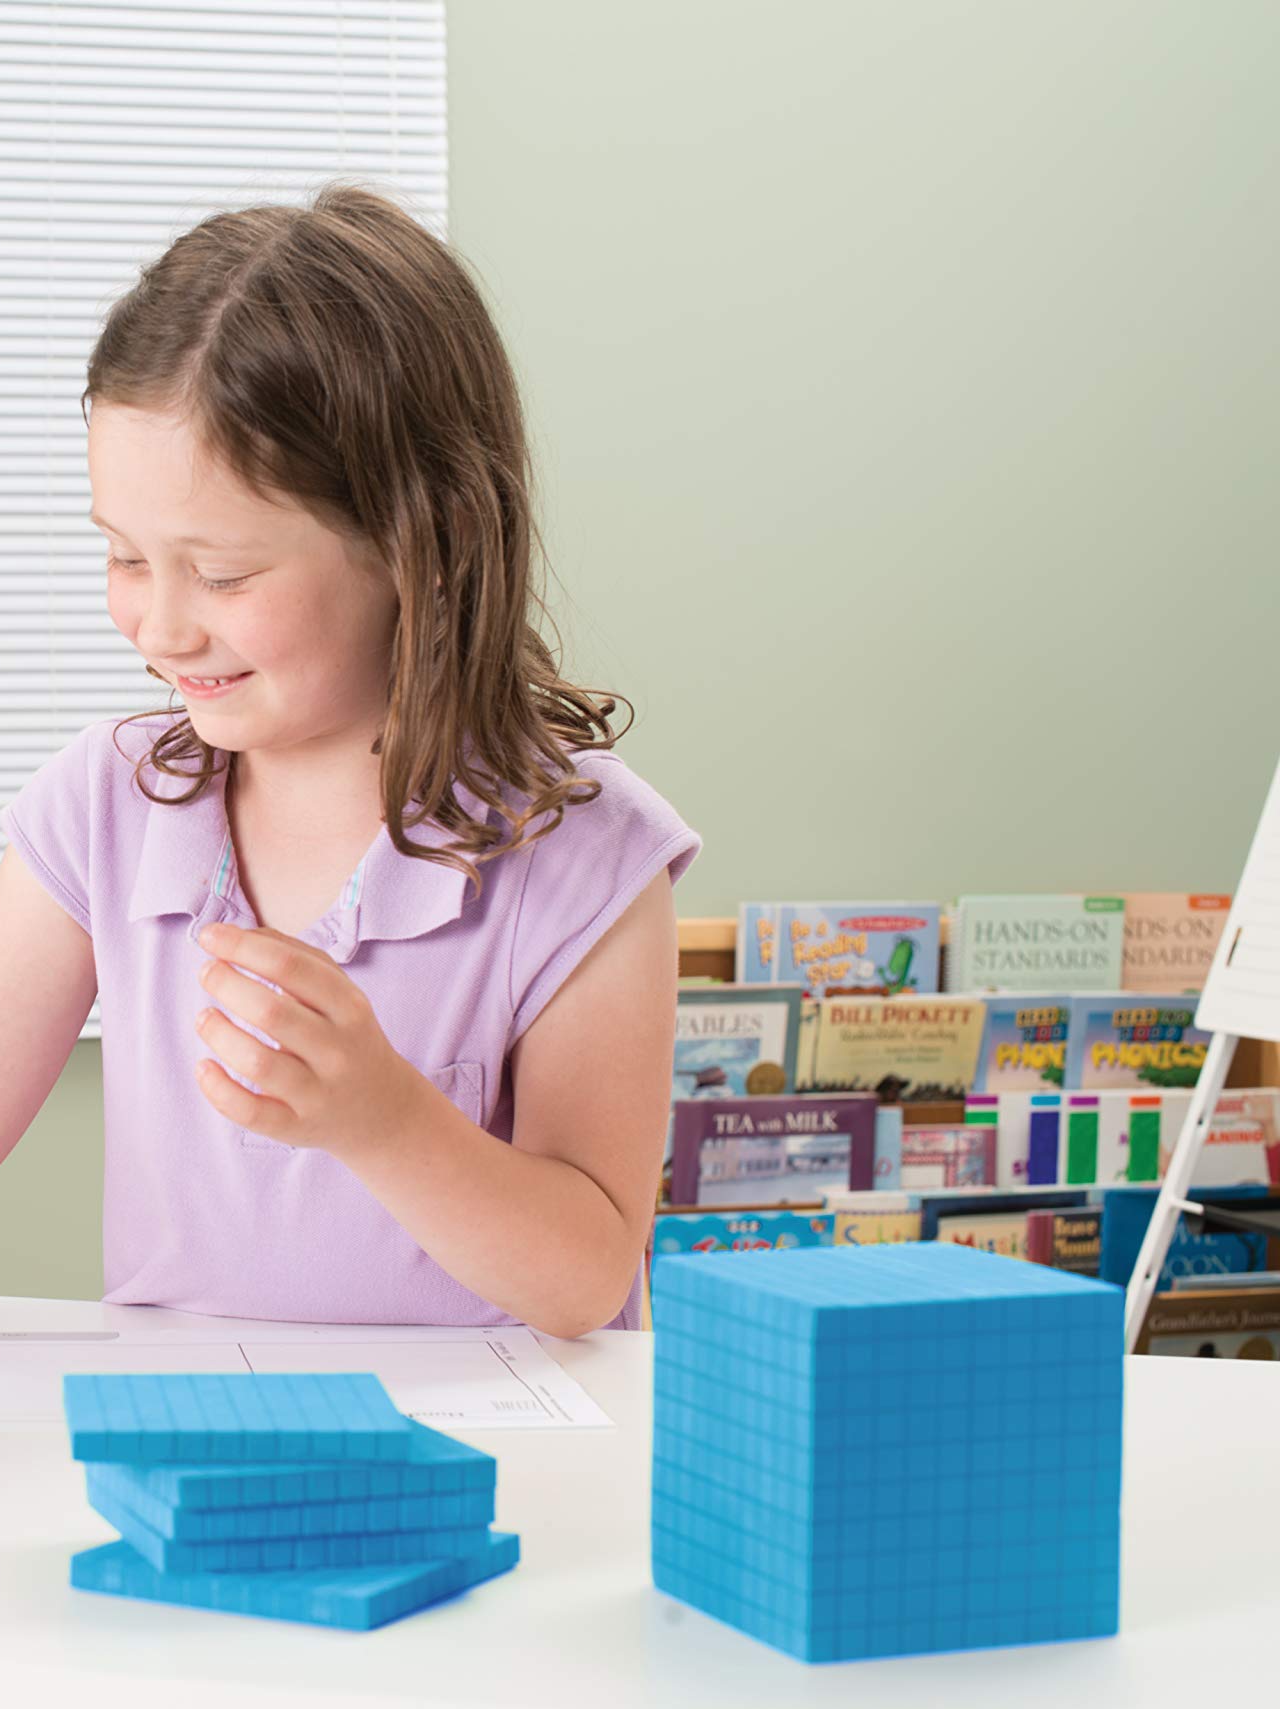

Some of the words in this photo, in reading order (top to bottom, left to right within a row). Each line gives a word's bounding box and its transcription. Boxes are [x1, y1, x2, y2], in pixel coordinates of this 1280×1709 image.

[974, 918, 1109, 945] HANDS-ON
[972, 947, 1109, 971] STANDARDS
[830, 1004, 873, 1026] BILL
[880, 1000, 972, 1026] PICKETT
[996, 1041, 1066, 1071] PHON
[1091, 1040, 1208, 1071] PHONICS
[713, 1112, 755, 1135] TEA
[757, 1116, 783, 1133] with
[784, 1109, 839, 1133] MILK
[1161, 1252, 1232, 1280] OON
